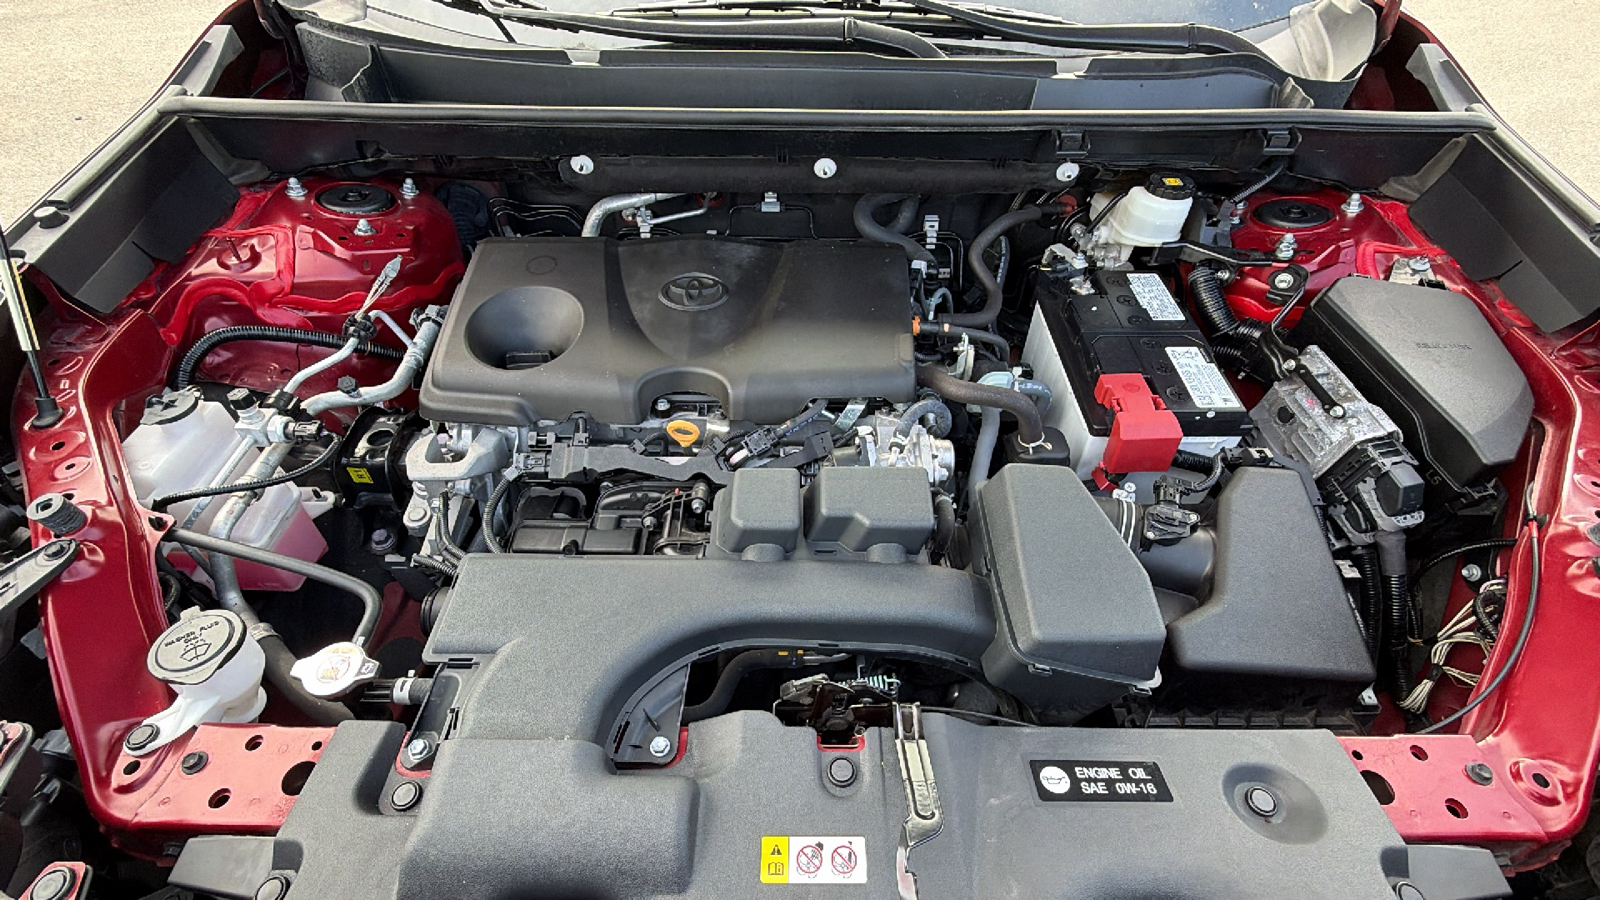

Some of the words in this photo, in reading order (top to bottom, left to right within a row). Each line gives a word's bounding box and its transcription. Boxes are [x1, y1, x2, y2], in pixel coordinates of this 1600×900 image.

[1074, 766, 1123, 779] ENGINE
[1128, 767, 1152, 779] OIL
[1080, 782, 1109, 794] SAE
